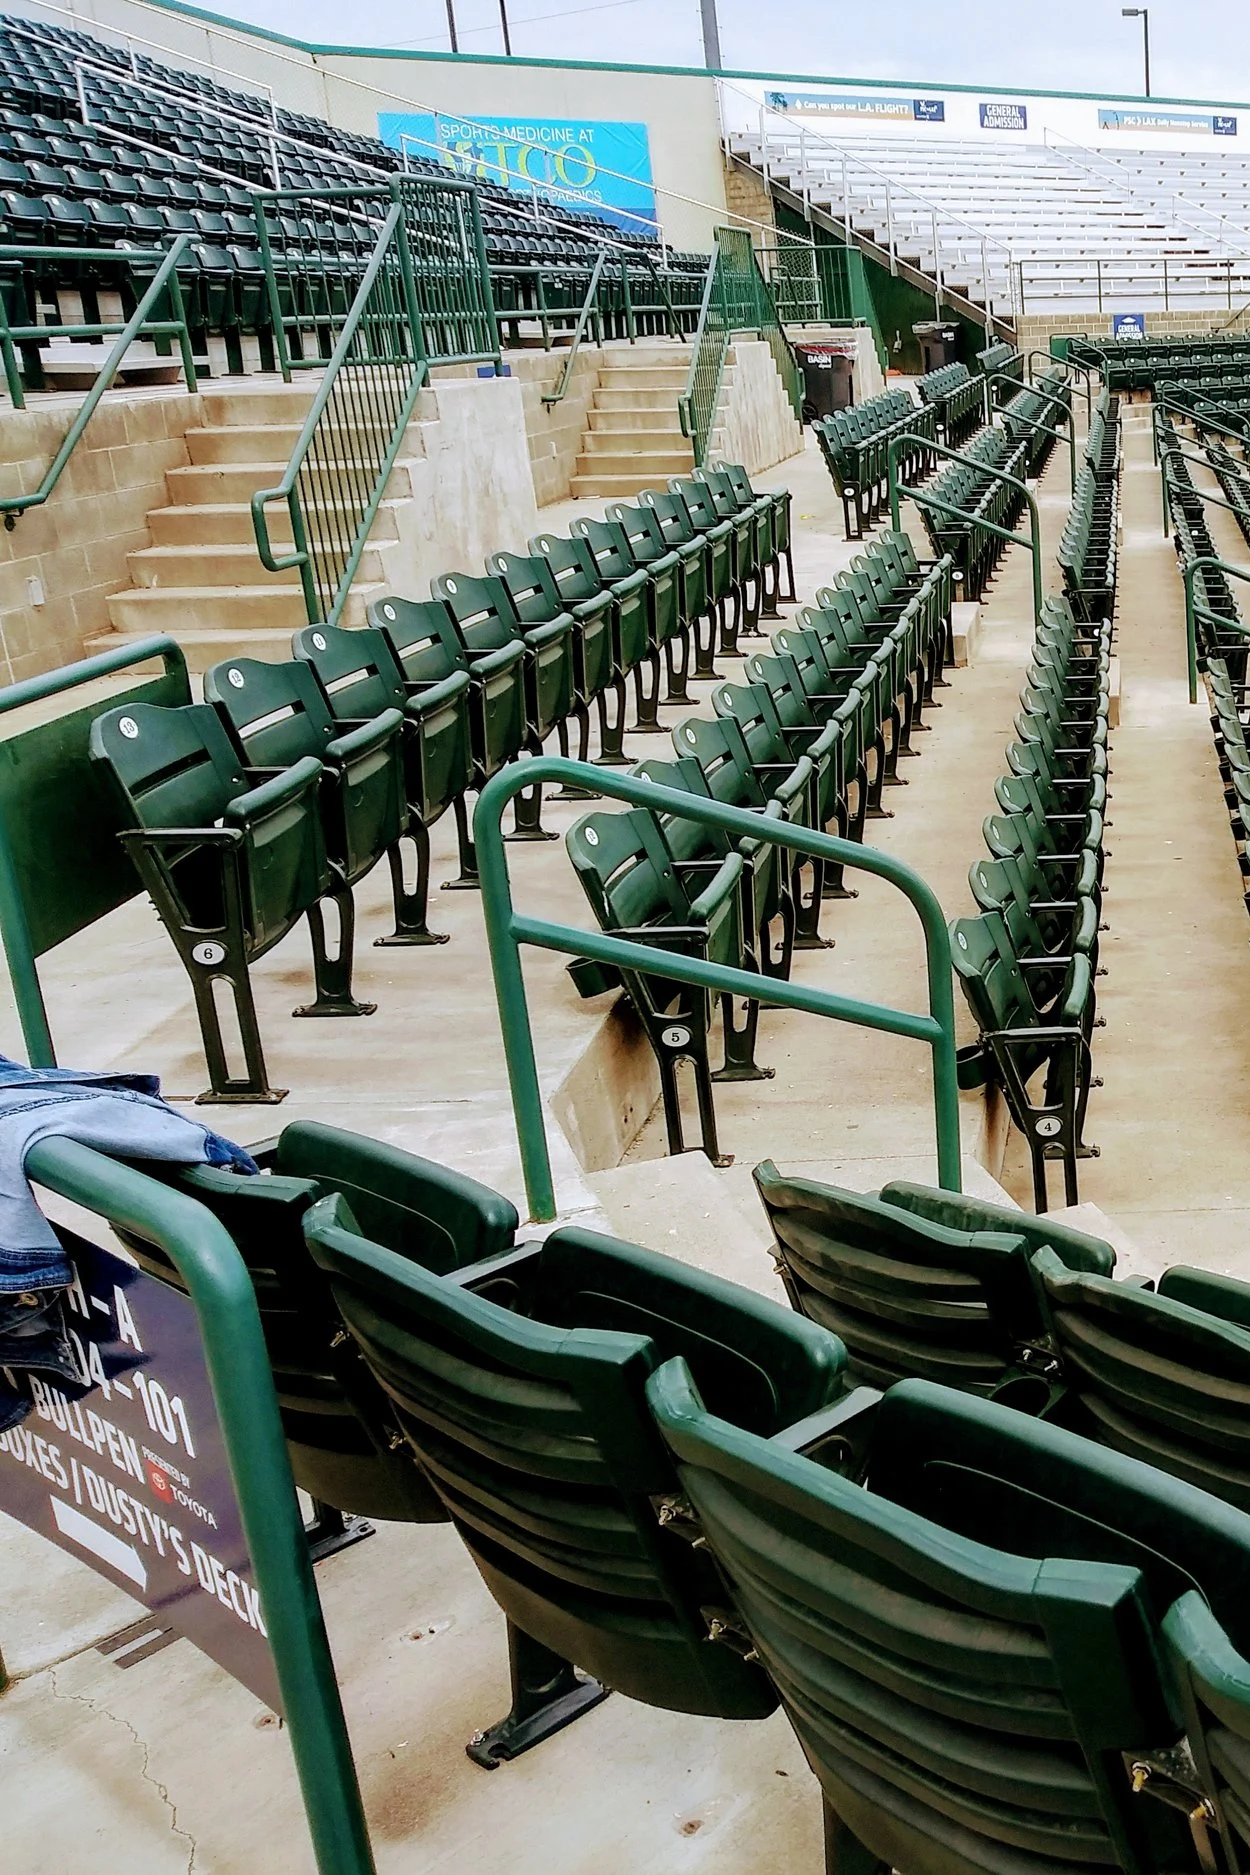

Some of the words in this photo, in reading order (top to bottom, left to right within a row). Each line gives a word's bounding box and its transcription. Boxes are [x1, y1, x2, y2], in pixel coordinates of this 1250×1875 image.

[817, 102, 830, 111] you
[831, 102, 845, 112] spot
[875, 104, 908, 114] FLIGHT?
[986, 105, 1020, 117] GENERAL
[984, 116, 1024, 128] ADMISSION
[440, 124, 500, 139] SPORTS
[503, 126, 575, 142] MEDICINE
[579, 129, 595, 143] AT
[1118, 324, 1141, 333] GENERAL
[807, 355, 832, 363] BASIN
[204, 948, 213, 959] 6
[671, 1032, 680, 1042] 5
[1044, 1122, 1052, 1132] 4
[28, 1373, 145, 1485] BULLPEN
[169, 1483, 217, 1530] TOYOTA
[81, 1463, 192, 1576] DUSTY'S
[190, 1540, 268, 1639] DECK
